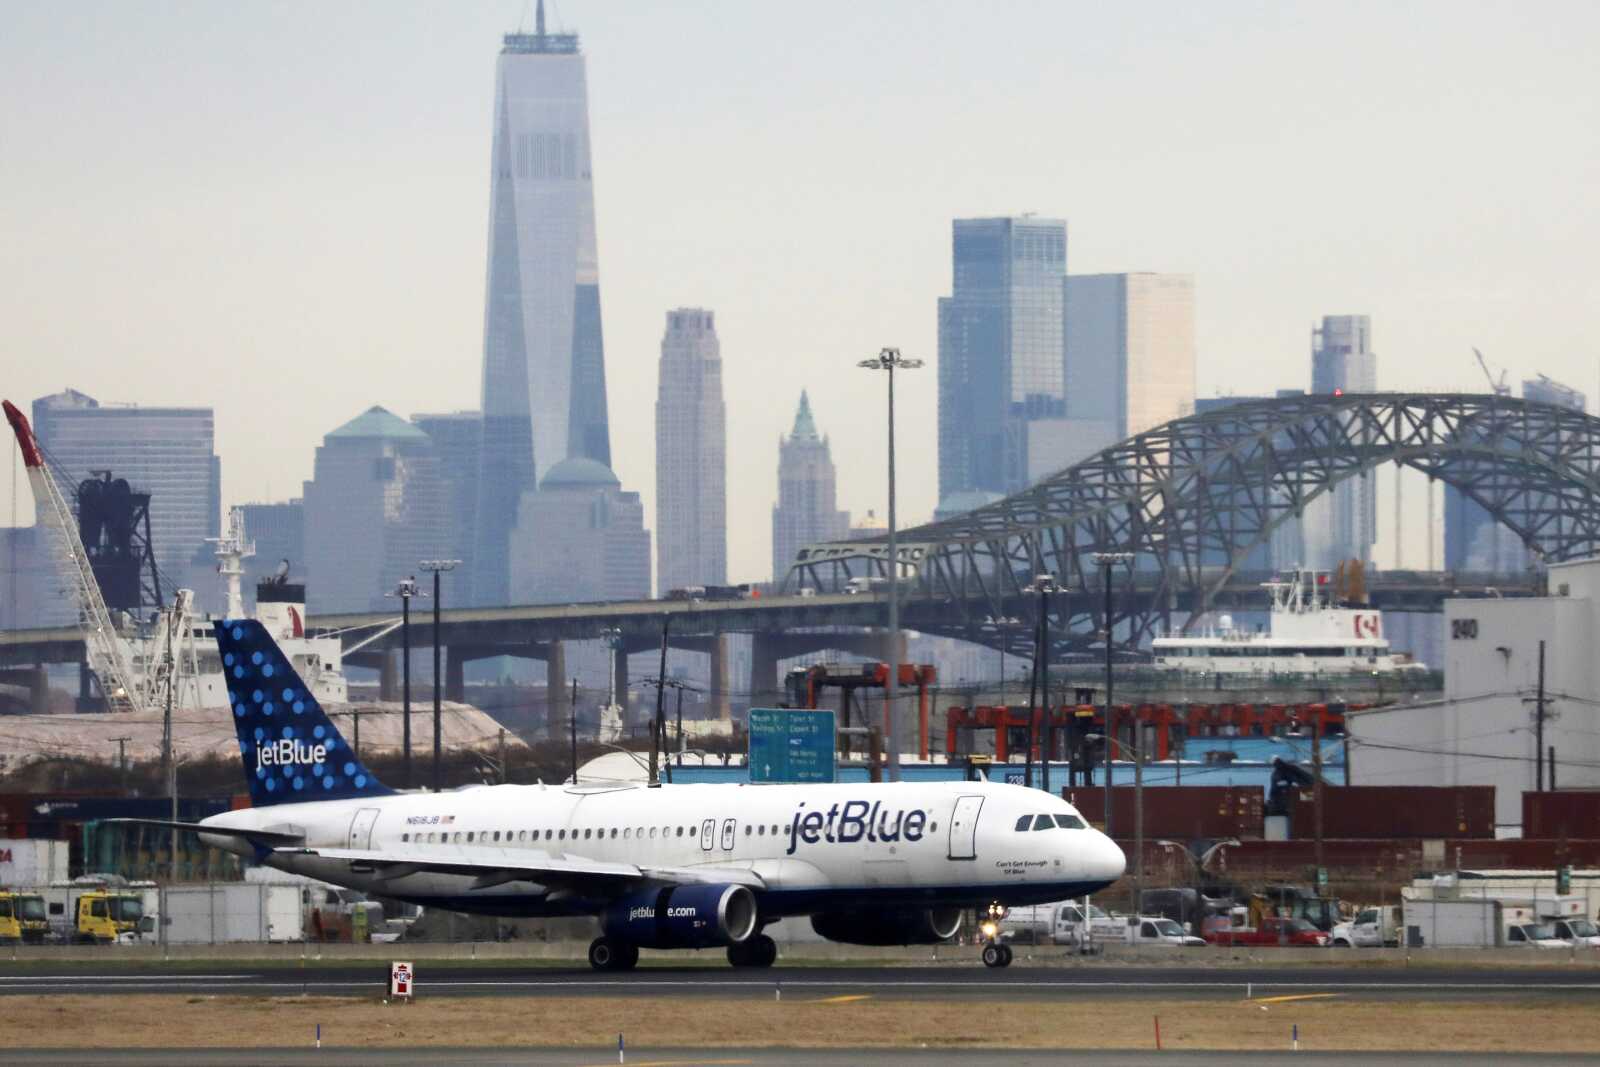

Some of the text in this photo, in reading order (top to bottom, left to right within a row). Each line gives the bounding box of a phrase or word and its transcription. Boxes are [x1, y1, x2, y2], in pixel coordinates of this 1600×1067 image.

[1452, 619, 1478, 640] 240
[256, 739, 327, 772] jetBlue
[786, 800, 926, 855] jetBlue
[995, 860, 1012, 868] Can't
[1024, 860, 1048, 868] Enough
